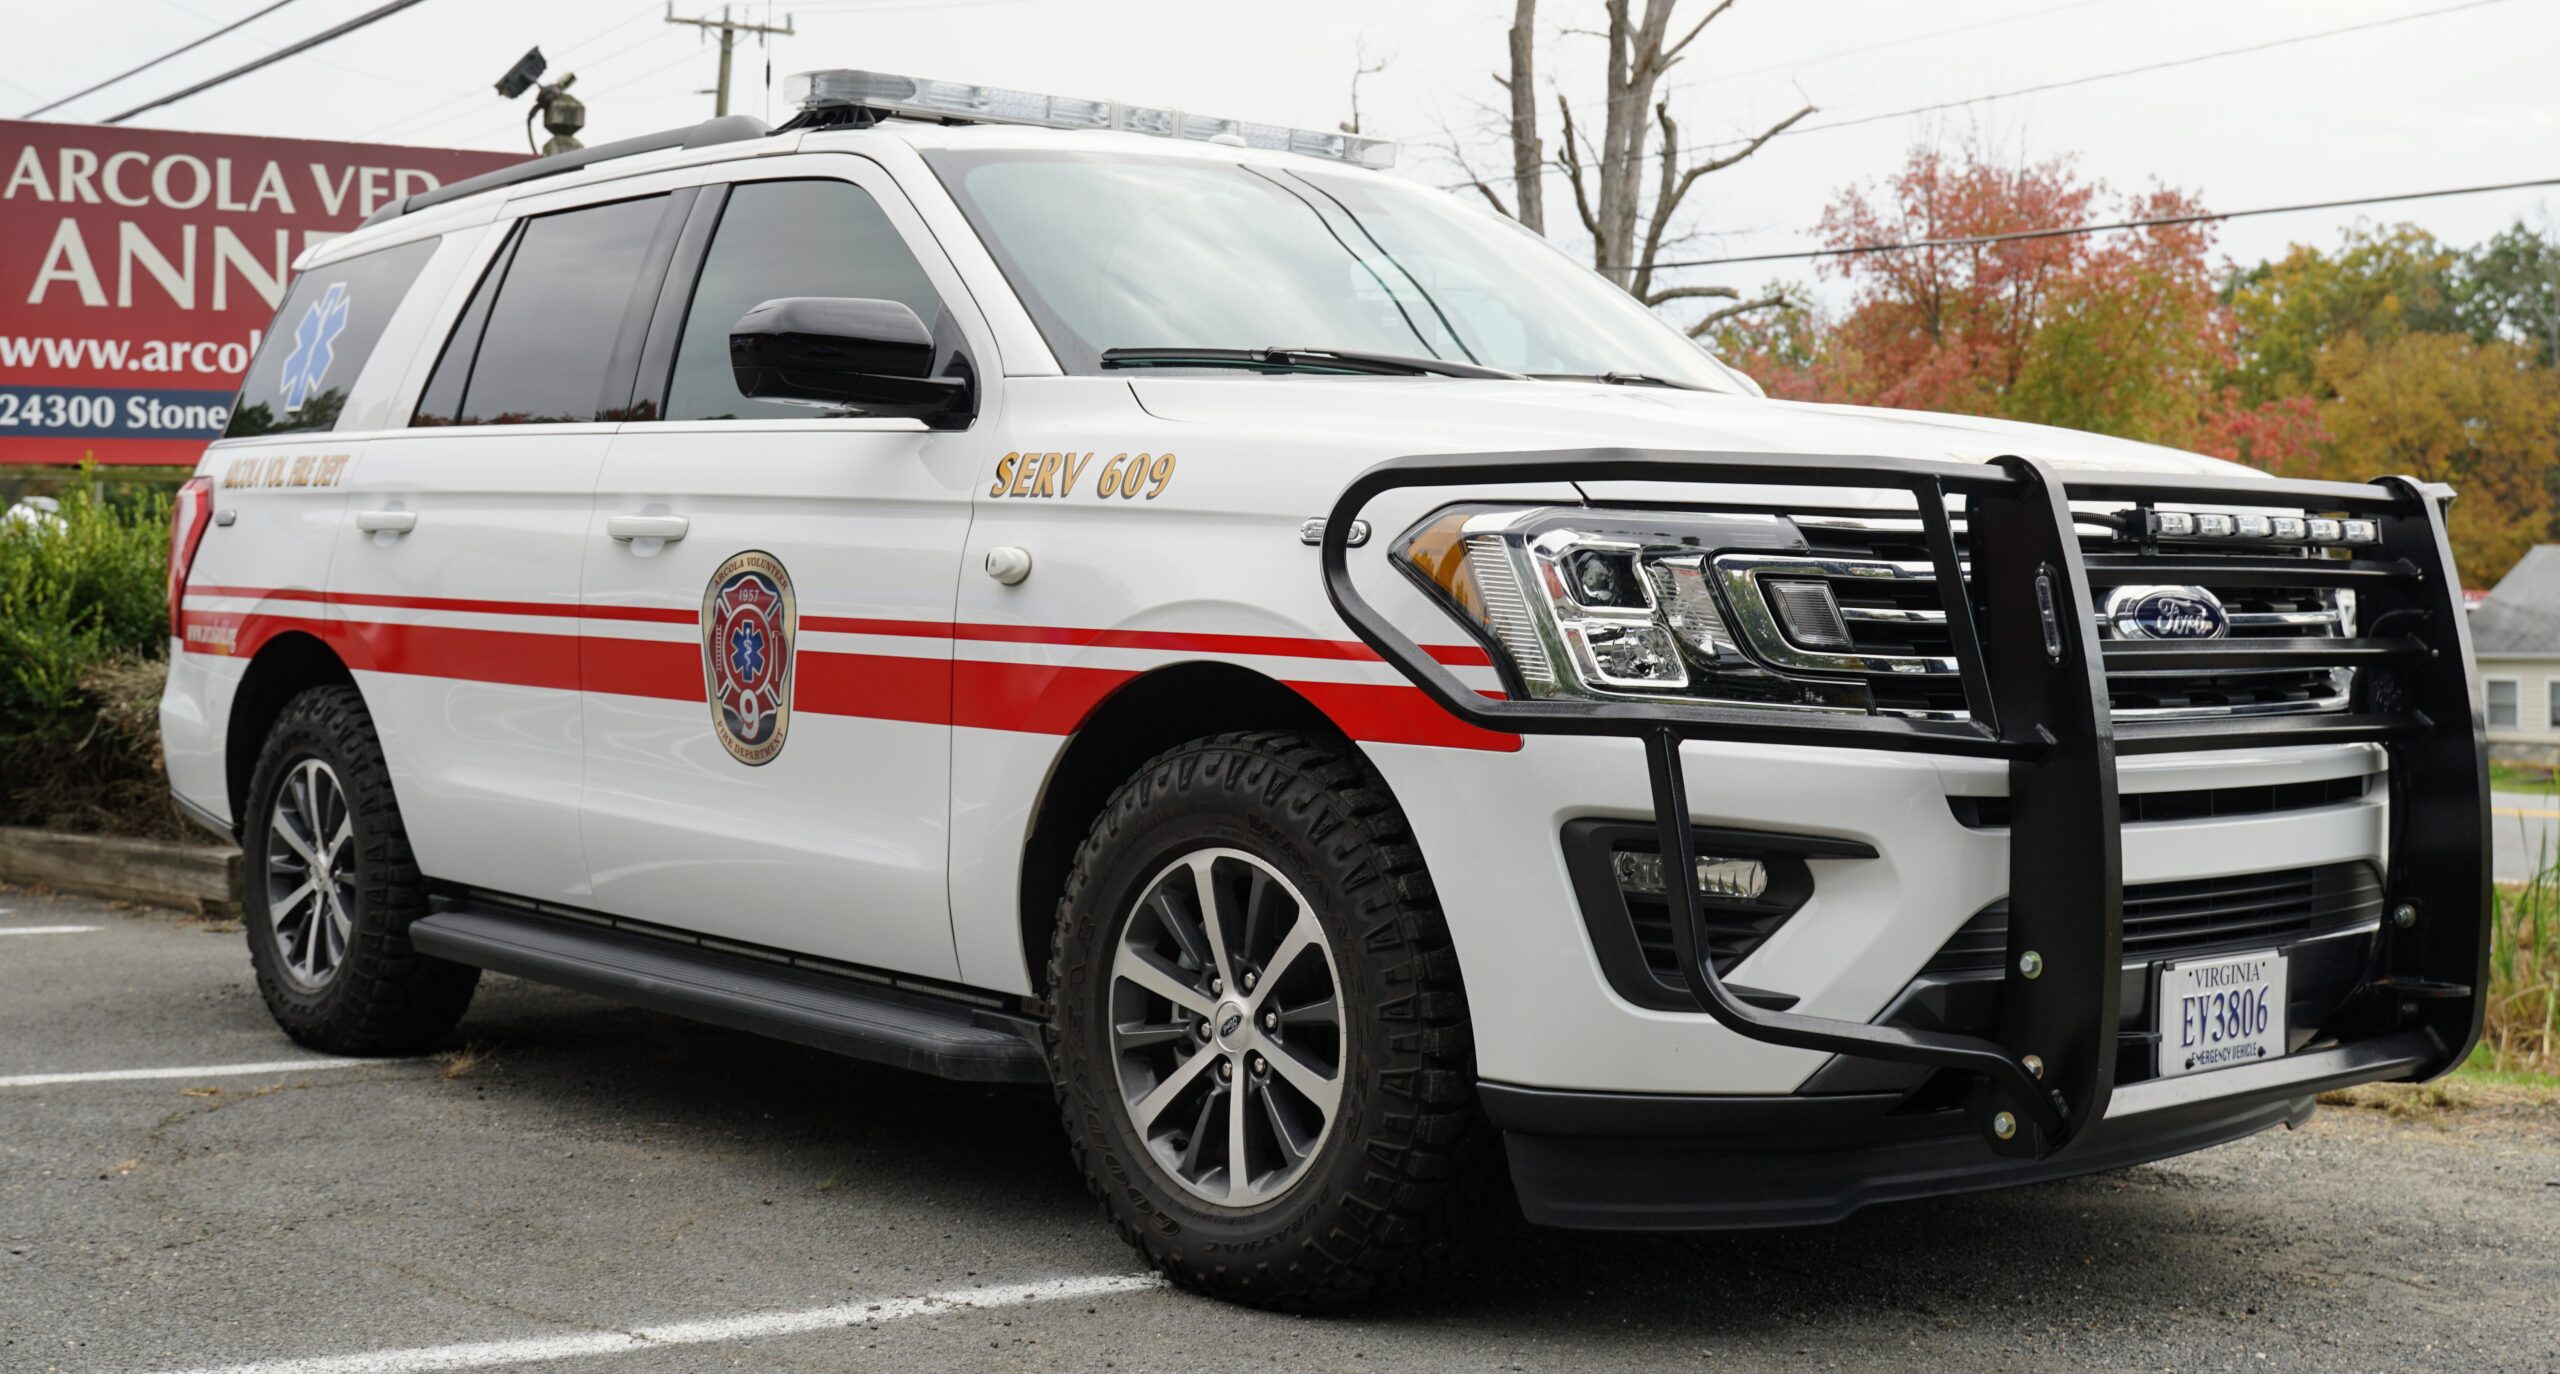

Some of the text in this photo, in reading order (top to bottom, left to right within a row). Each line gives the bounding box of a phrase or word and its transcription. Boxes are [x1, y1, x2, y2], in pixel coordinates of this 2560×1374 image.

[4, 145, 297, 214] ARCOLA
[27, 217, 351, 311] ANN
[0, 393, 229, 431] 24300 Stone
[990, 451, 1176, 500] SERV 609
[715, 557, 788, 591] ARCOLA VOLUNTEER
[739, 589, 759, 602] 1957
[2157, 598, 2213, 635] Ford
[739, 689, 760, 740] 9
[717, 720, 783, 760] FIRE DEPARTMENT
[2195, 962, 2260, 988] VIRGINIA
[1222, 1015, 1240, 1036] Ford
[2180, 984, 2269, 1048] EV3806
[2191, 1042, 2257, 1066] EMERGENCY VEHICLE
